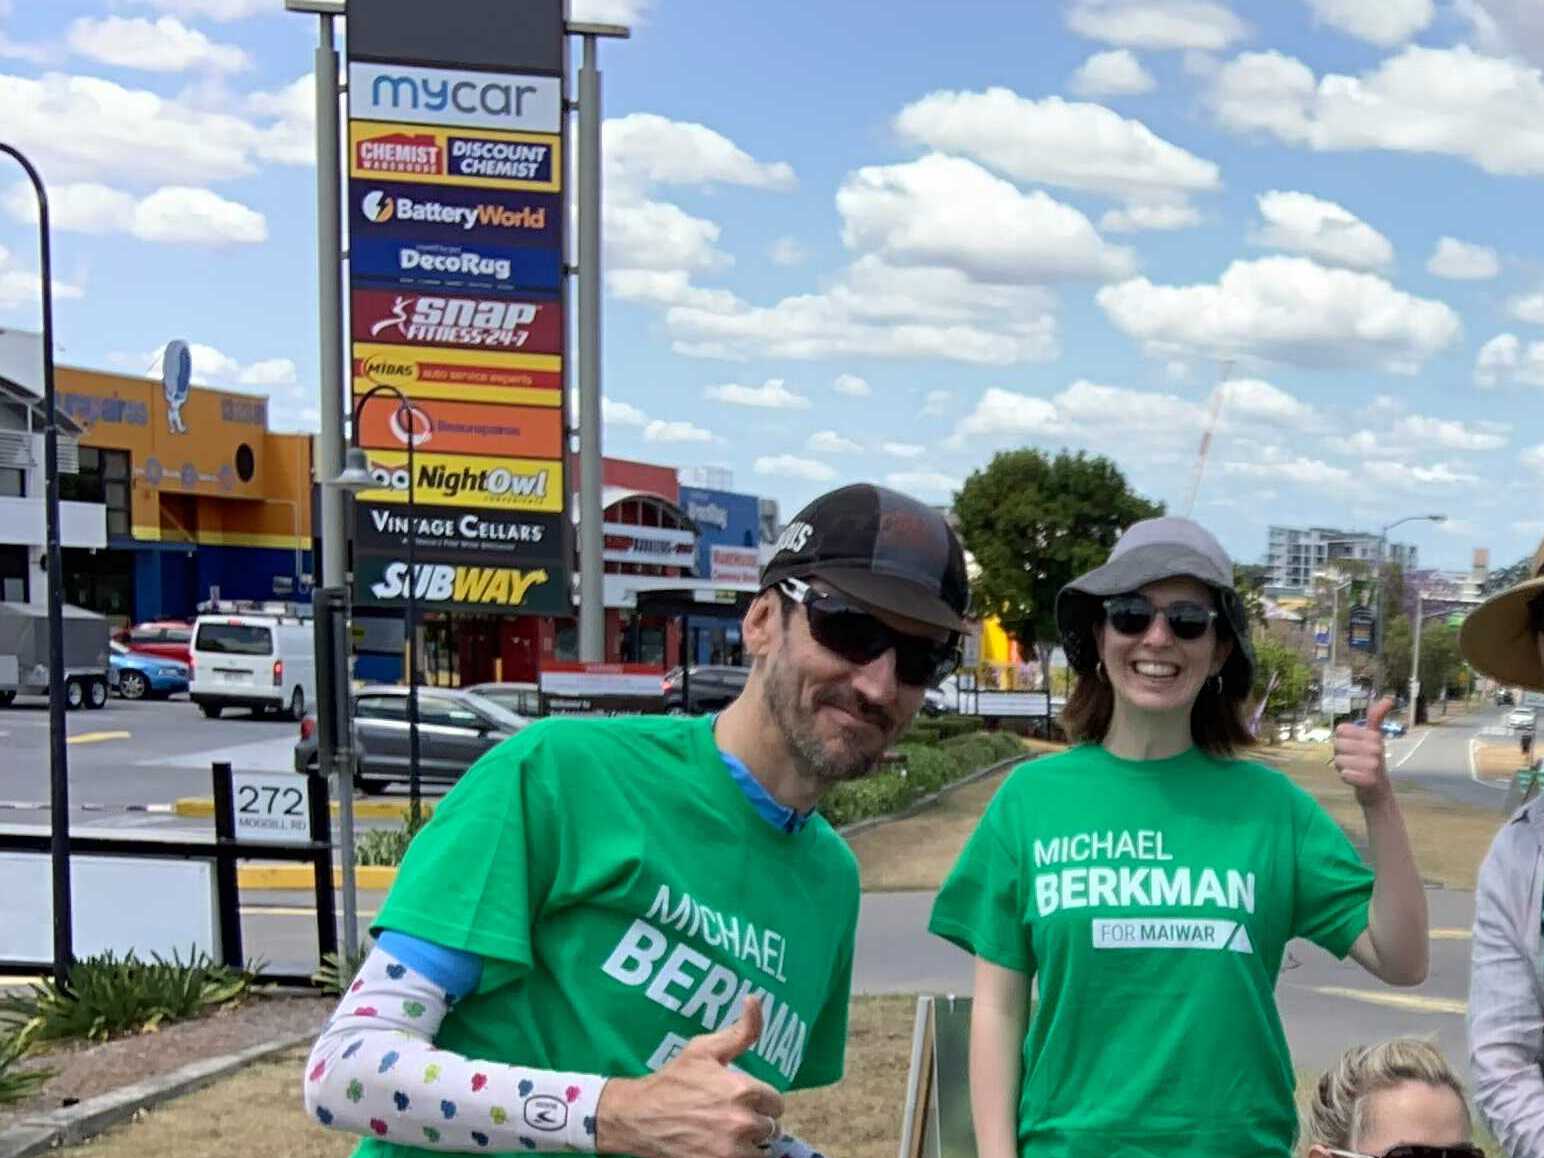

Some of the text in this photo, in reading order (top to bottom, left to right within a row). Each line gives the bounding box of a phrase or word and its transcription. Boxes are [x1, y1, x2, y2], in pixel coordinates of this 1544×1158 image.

[372, 74, 537, 117] mycar
[360, 142, 439, 164] CHEMIST
[452, 141, 547, 161] DISCOUNT
[460, 159, 539, 178] CHEMIST
[400, 248, 511, 280] DecoRug
[422, 369, 533, 386] auto service experts
[371, 510, 544, 543] VINAGE CELLARS
[370, 562, 549, 605] SUBWAY
[238, 785, 304, 816] 272
[1034, 830, 1174, 868] MICHAEL
[1035, 867, 1255, 917] BERKMAN
[646, 884, 787, 983] MICHAEL
[1101, 924, 1216, 943] FOR MAIWAR
